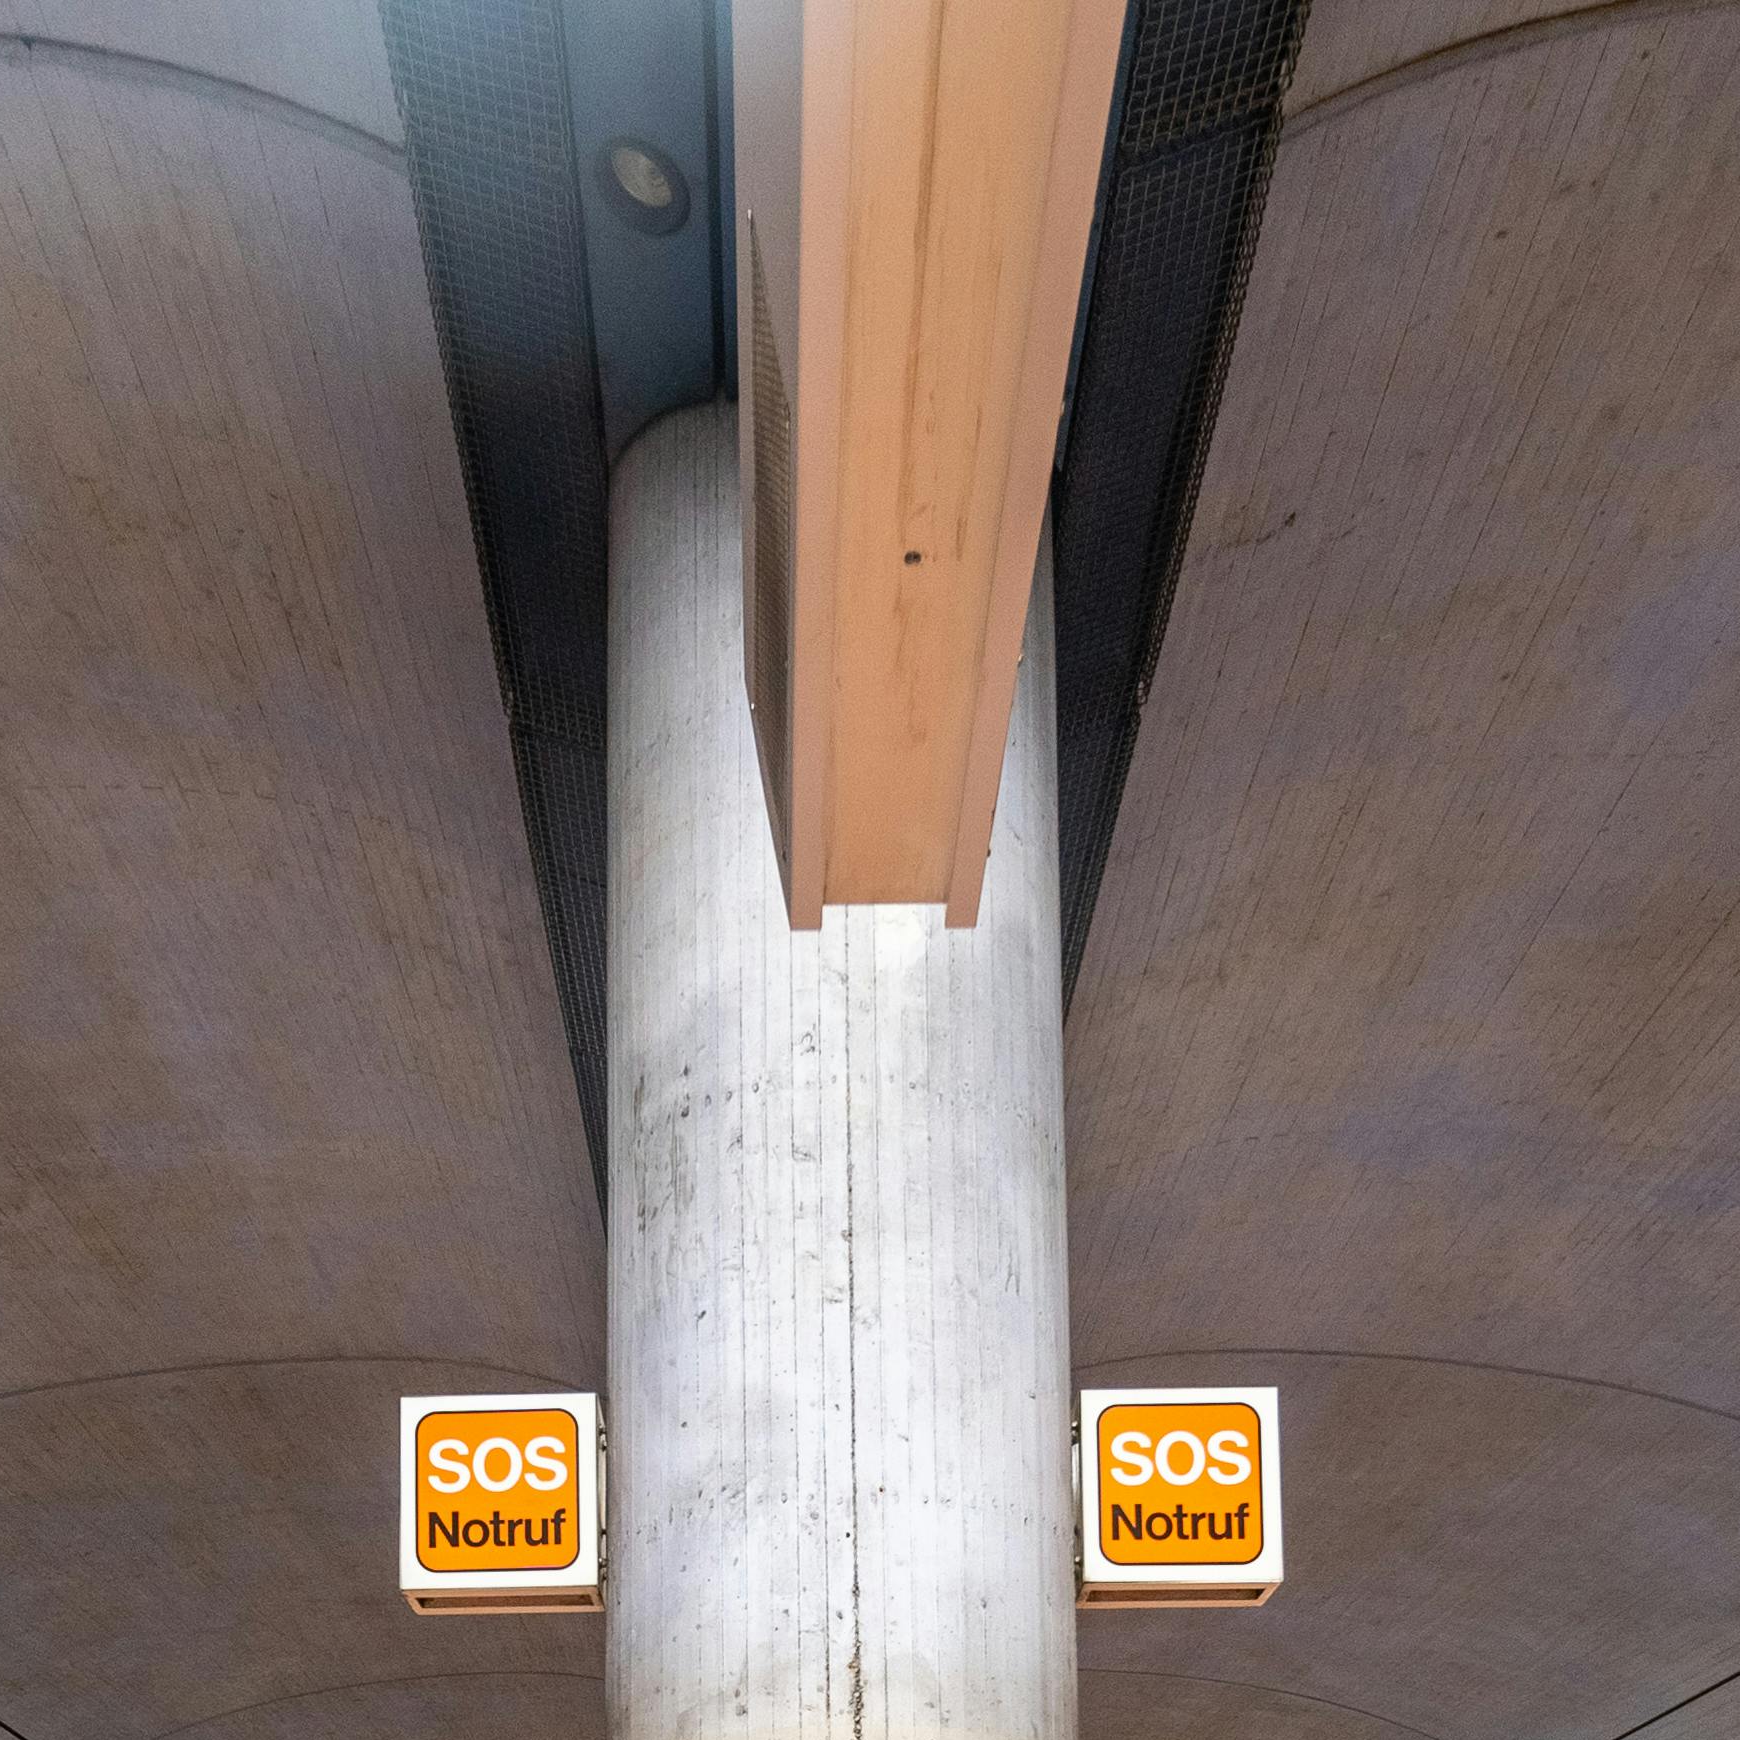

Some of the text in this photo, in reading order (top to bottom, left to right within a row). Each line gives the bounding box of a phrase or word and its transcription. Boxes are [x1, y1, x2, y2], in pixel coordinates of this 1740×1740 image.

[427, 1436, 569, 1494] SOS
[1110, 1430, 1252, 1486] SOS
[428, 1508, 566, 1548] Notruf
[1111, 1503, 1250, 1540] Notruf
